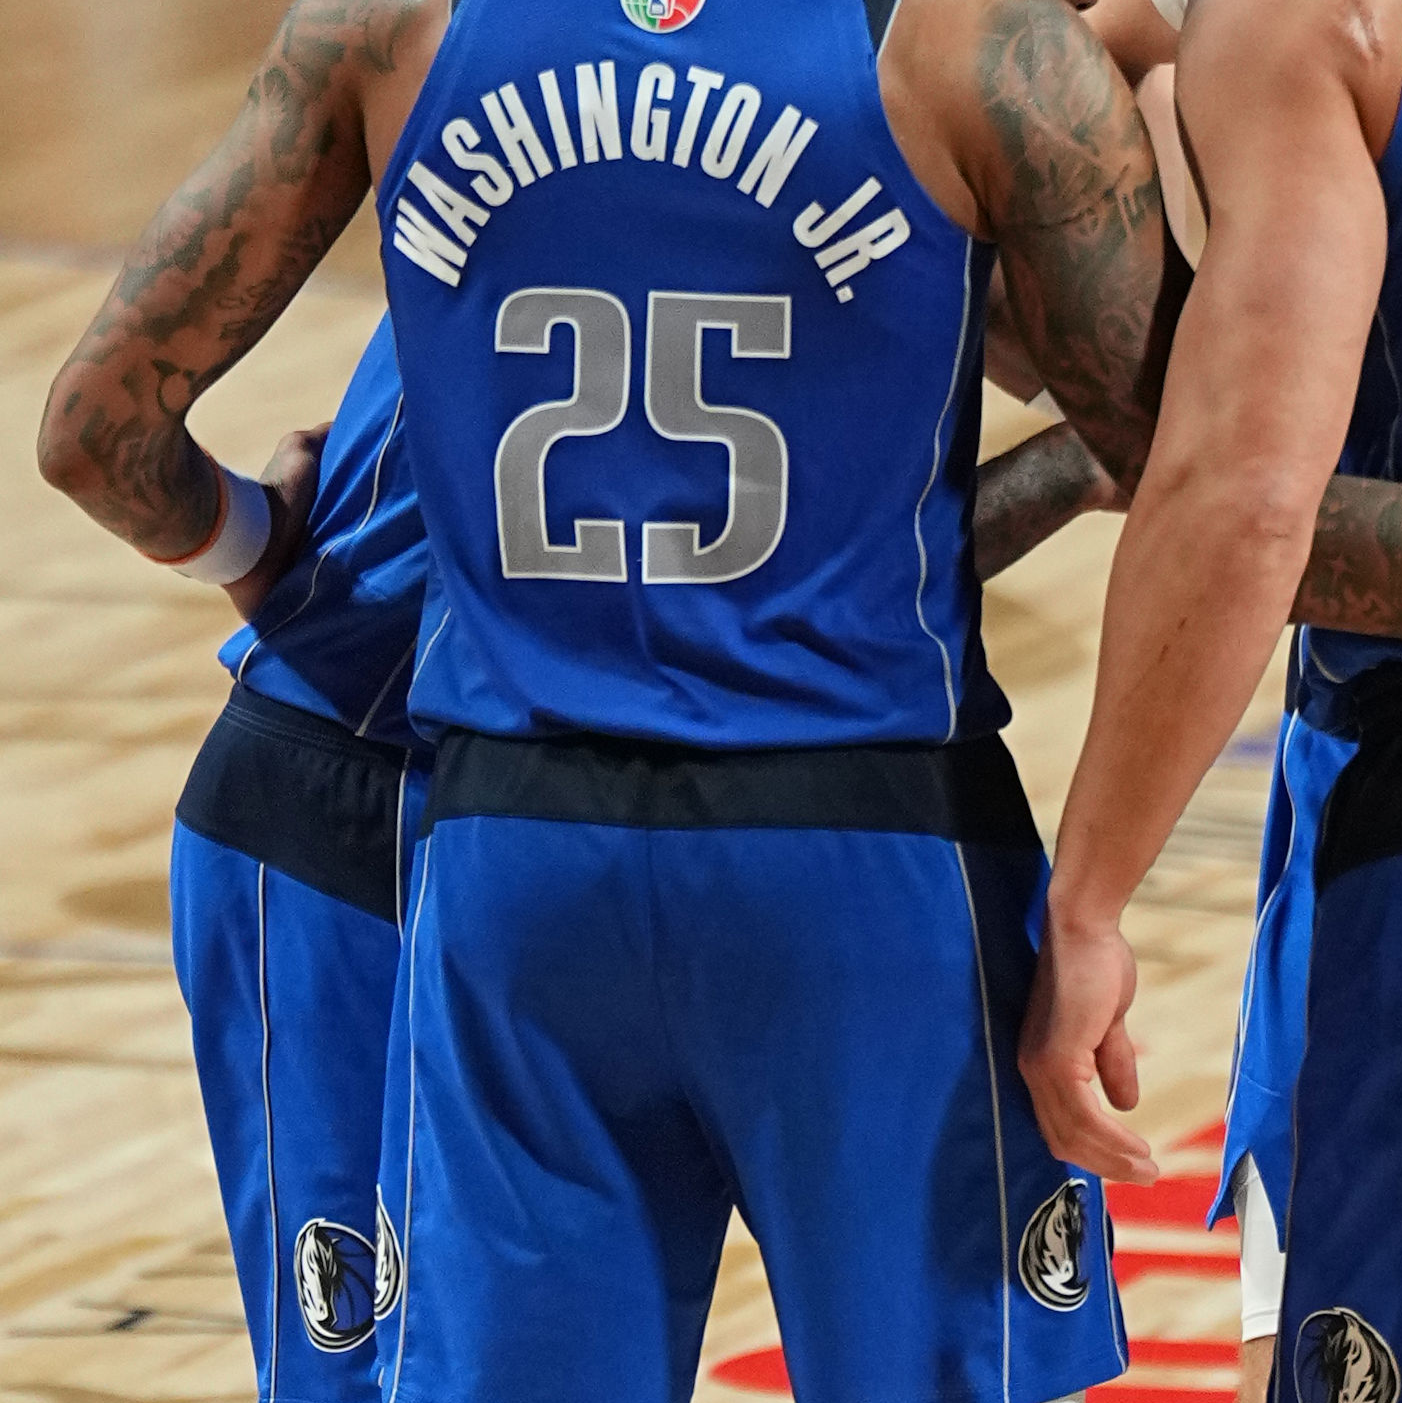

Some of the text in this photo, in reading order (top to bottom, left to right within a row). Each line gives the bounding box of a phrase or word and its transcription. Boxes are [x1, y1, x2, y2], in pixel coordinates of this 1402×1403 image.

[393, 61, 912, 305] WASHINGTON JR.
[494, 287, 793, 587] 25
